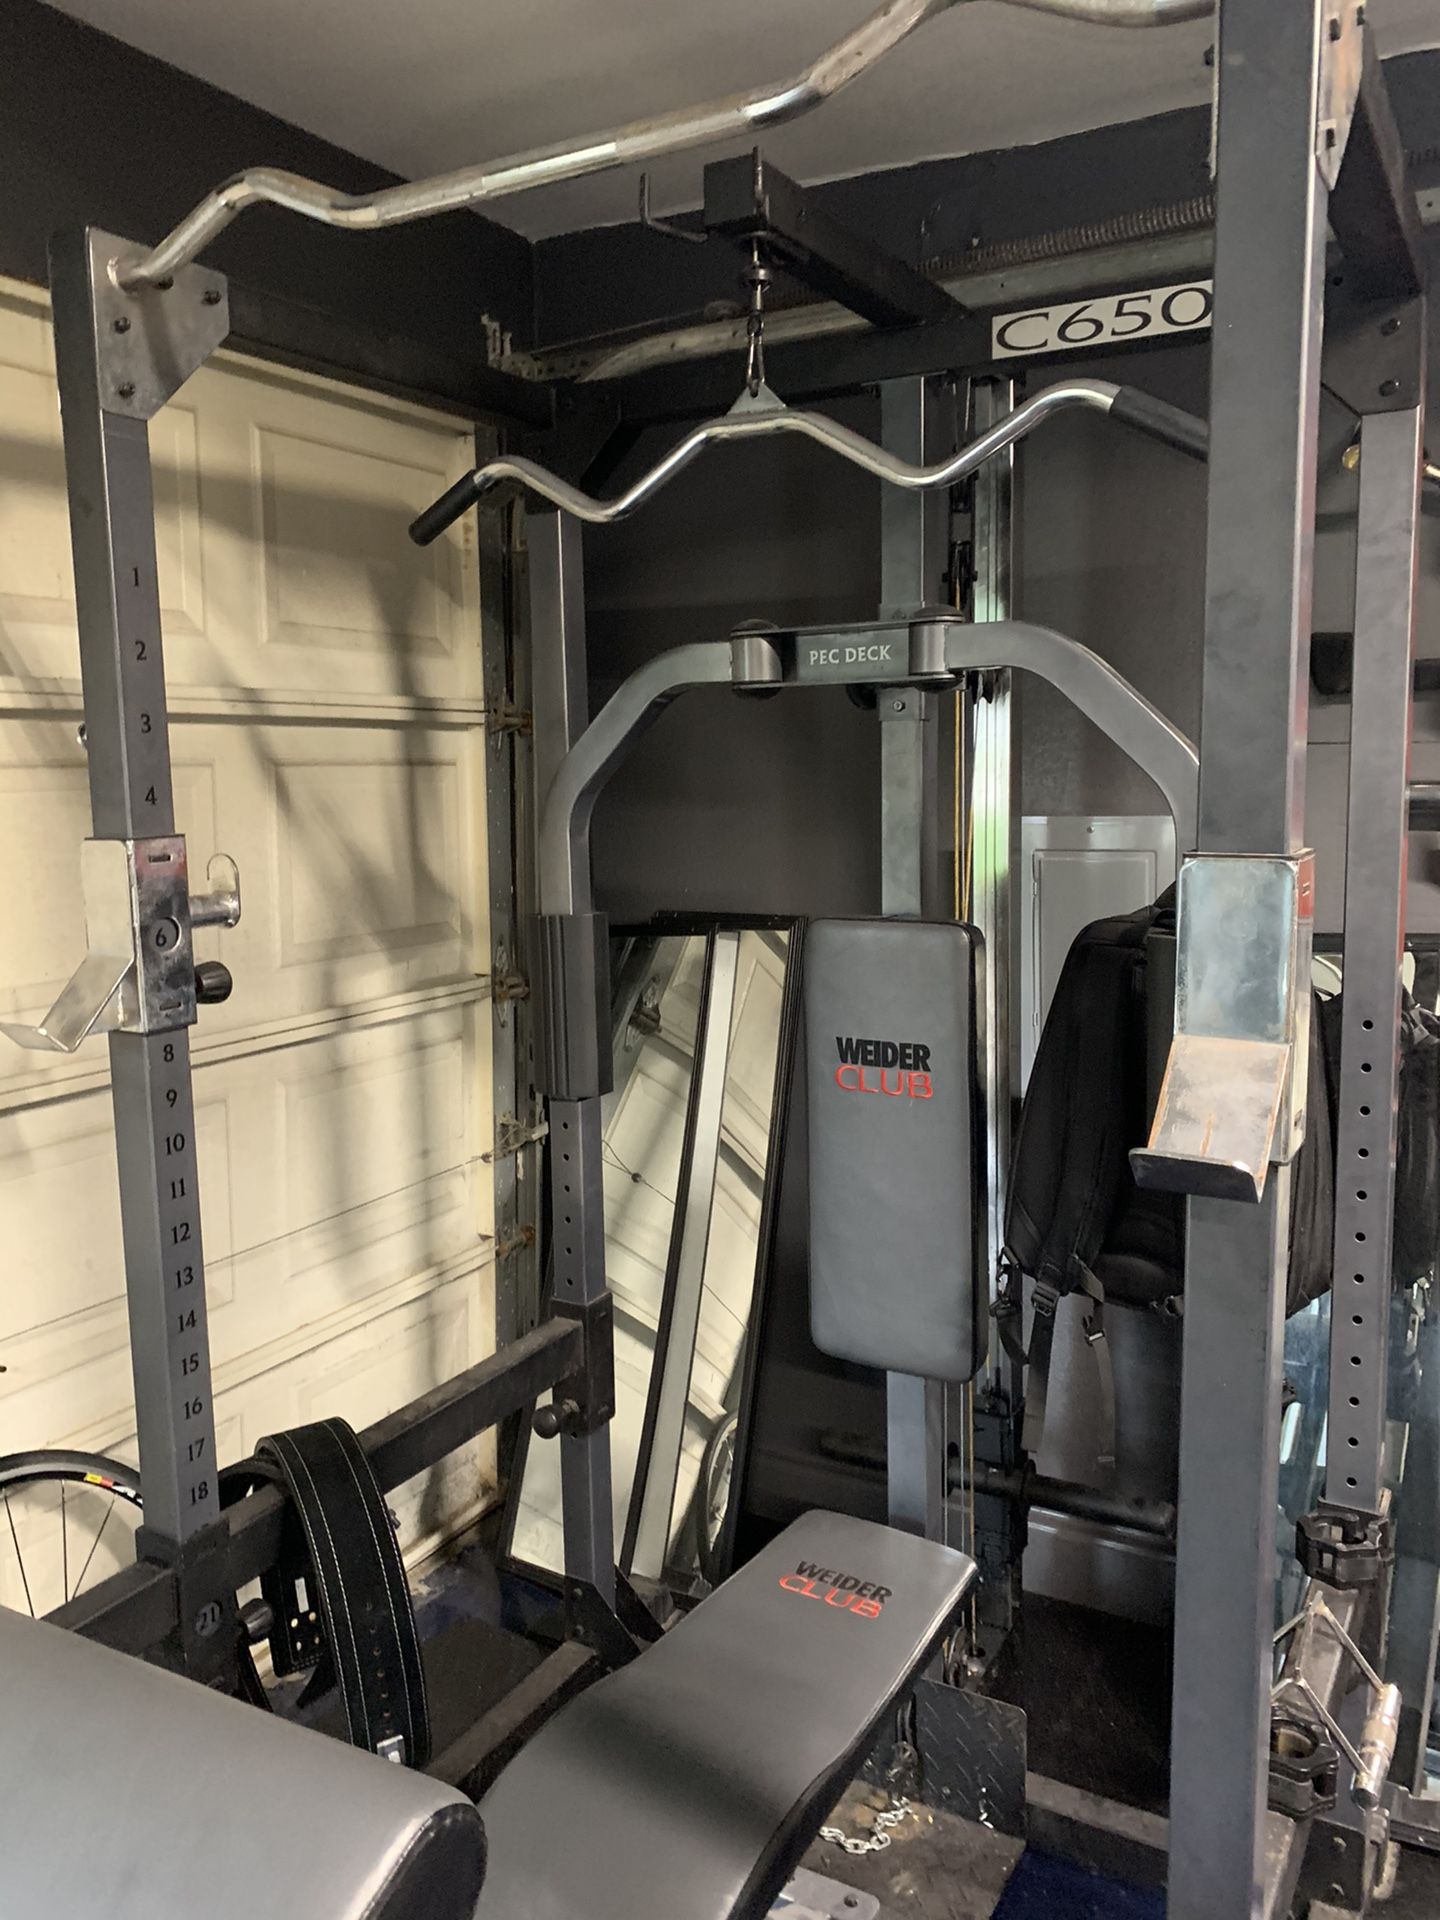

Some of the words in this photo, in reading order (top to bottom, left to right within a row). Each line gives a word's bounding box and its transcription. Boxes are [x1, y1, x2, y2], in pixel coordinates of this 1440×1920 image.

[996, 287, 1213, 351] C650
[132, 566, 139, 586] 1
[135, 640, 147, 661] 2
[809, 648, 840, 665] PEC
[845, 644, 891, 663] DECK
[141, 713, 150, 733] 3
[145, 785, 157, 805] 4
[155, 927, 167, 947] 6
[163, 1043, 174, 1063] 8
[836, 1036, 931, 1072] WEIDER
[835, 1064, 934, 1099] CLUB
[166, 1089, 177, 1108] 9
[166, 1133, 185, 1155] 10
[171, 1178, 186, 1199] 11
[171, 1222, 191, 1245] 12
[175, 1266, 194, 1289] 13
[177, 1309, 197, 1333] 14
[181, 1352, 200, 1376] 15
[184, 1396, 203, 1420] 16
[187, 1438, 205, 1462] 17
[190, 1481, 209, 1505] 18
[795, 1561, 893, 1604] WEIDER
[778, 1573, 882, 1620] CLUB
